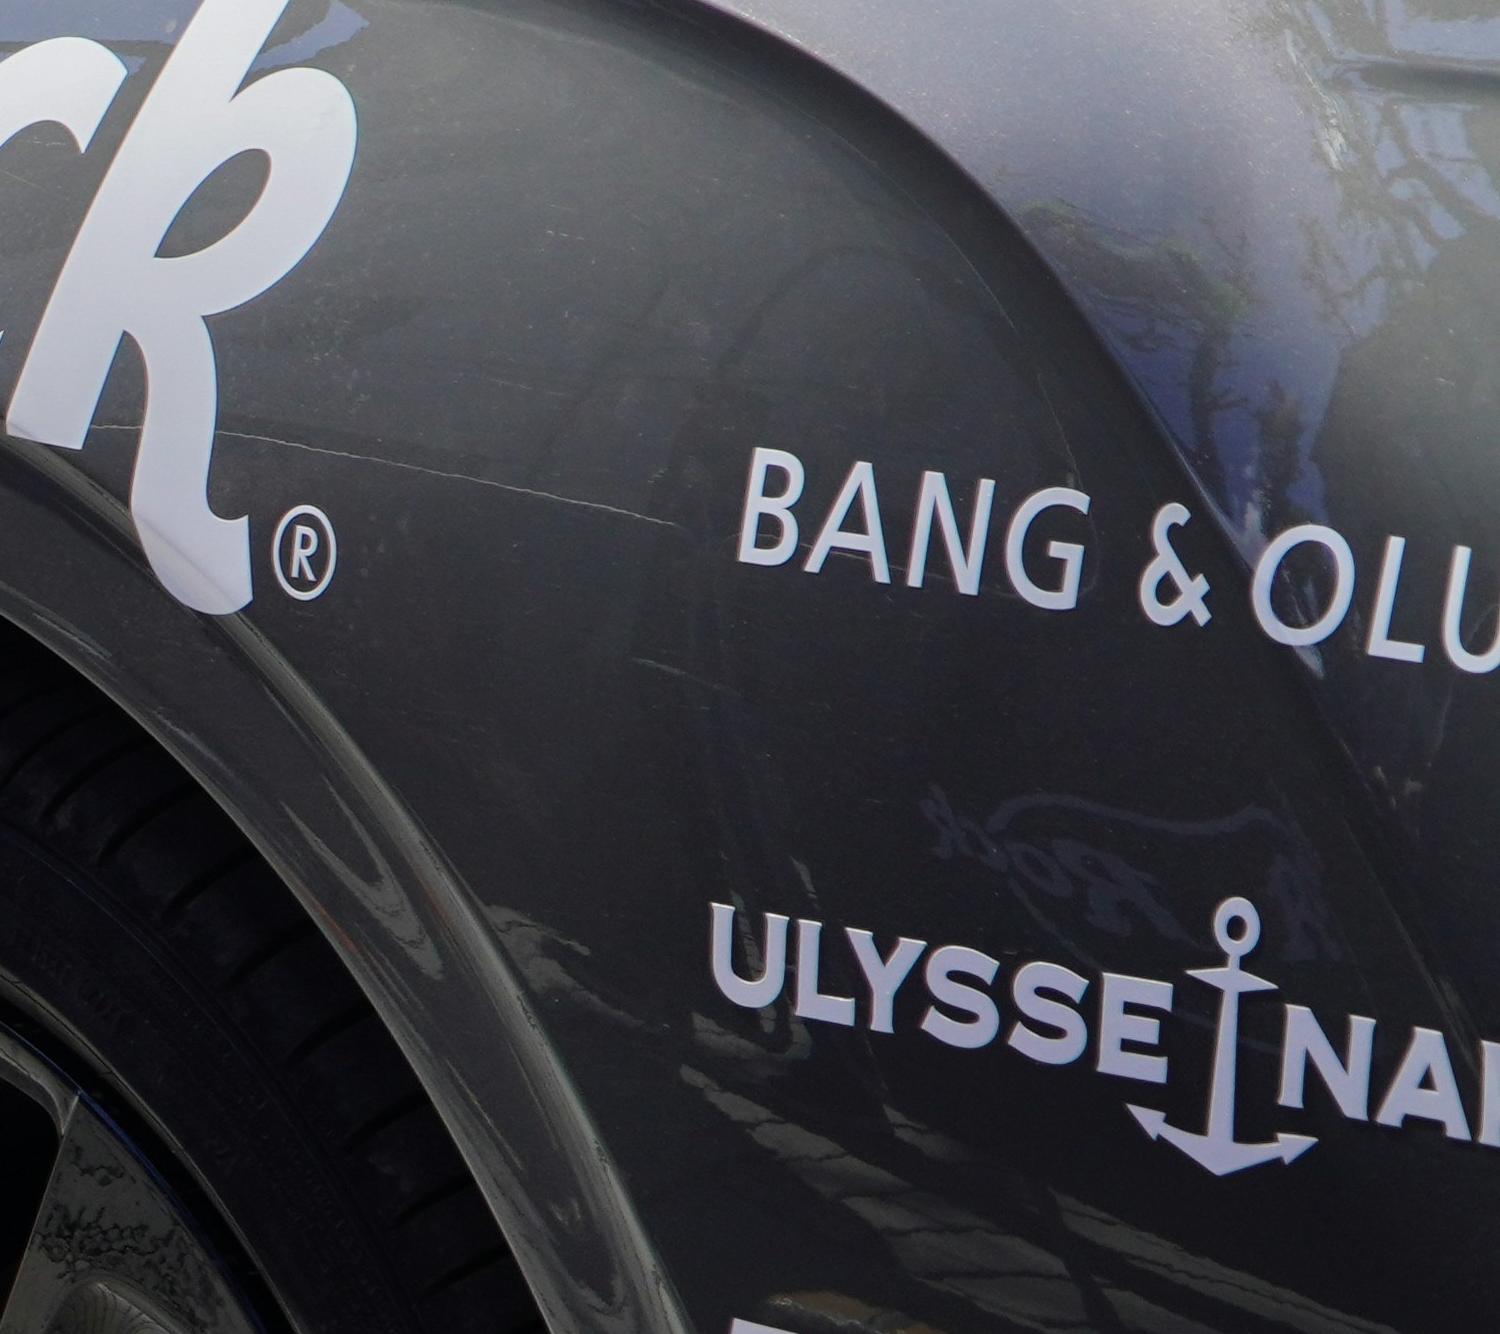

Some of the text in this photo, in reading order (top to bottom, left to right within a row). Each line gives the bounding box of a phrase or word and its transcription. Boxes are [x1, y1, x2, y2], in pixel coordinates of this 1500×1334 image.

[736, 446, 1500, 674] BANG & OLU
[709, 902, 1175, 1085] ULYSSE
